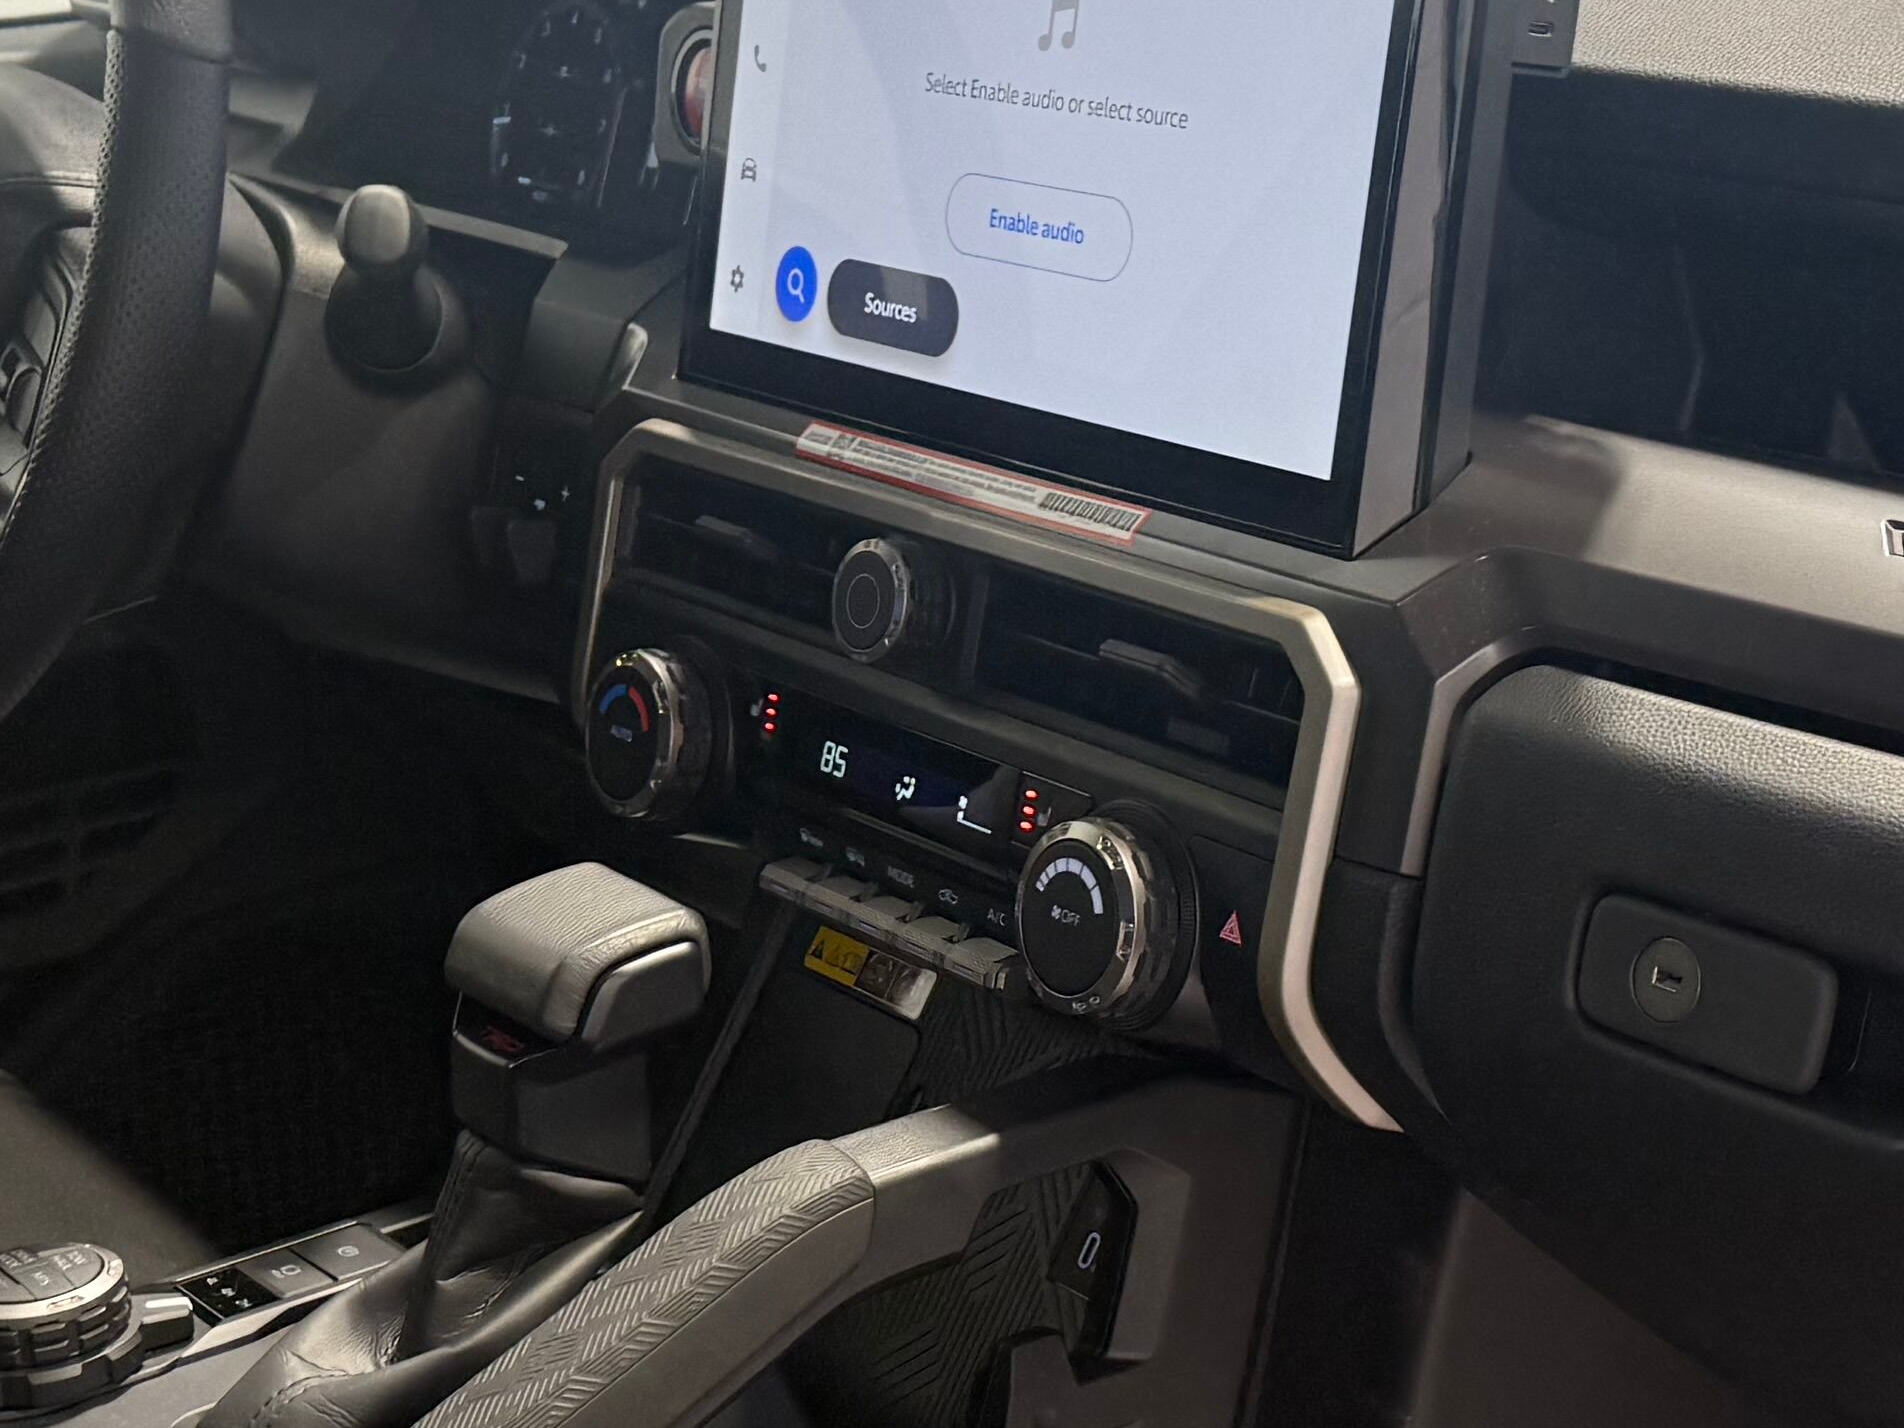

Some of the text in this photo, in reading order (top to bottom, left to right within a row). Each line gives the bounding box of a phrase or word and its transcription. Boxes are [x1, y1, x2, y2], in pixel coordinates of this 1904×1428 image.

[924, 71, 1189, 130] Select Enable audio or select source
[989, 207, 1085, 245] Enable audio
[863, 291, 918, 324] Sources
[819, 739, 849, 779] 85
